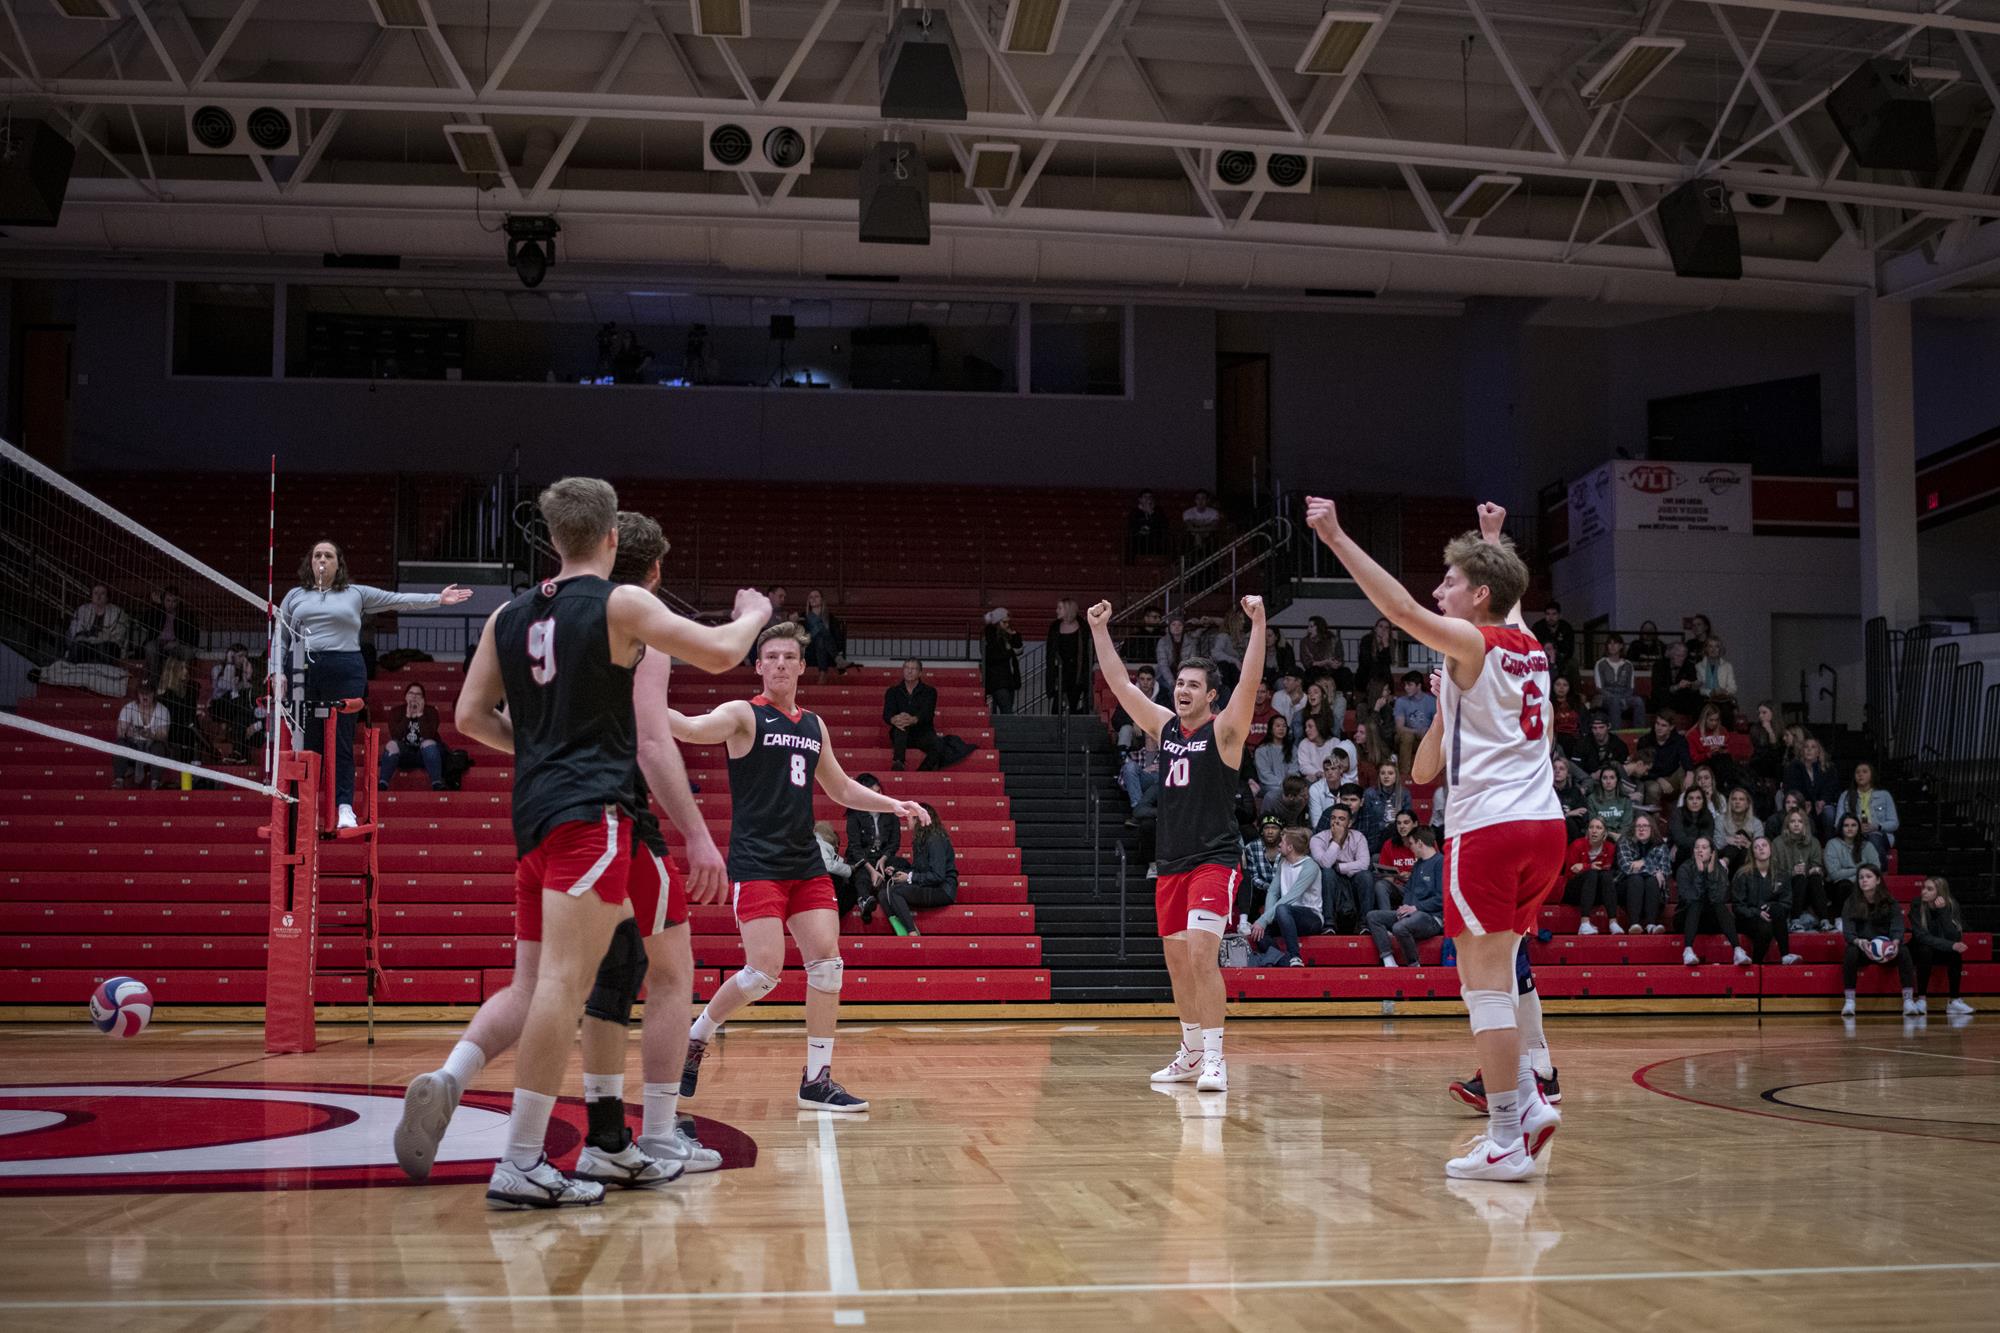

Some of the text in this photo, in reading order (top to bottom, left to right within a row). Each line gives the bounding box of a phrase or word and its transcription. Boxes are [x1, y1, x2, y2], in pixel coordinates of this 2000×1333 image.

[527, 617, 557, 685] 9
[1519, 679, 1544, 741] 6
[763, 733, 821, 754] CARTHAGE
[790, 753, 806, 787] 8
